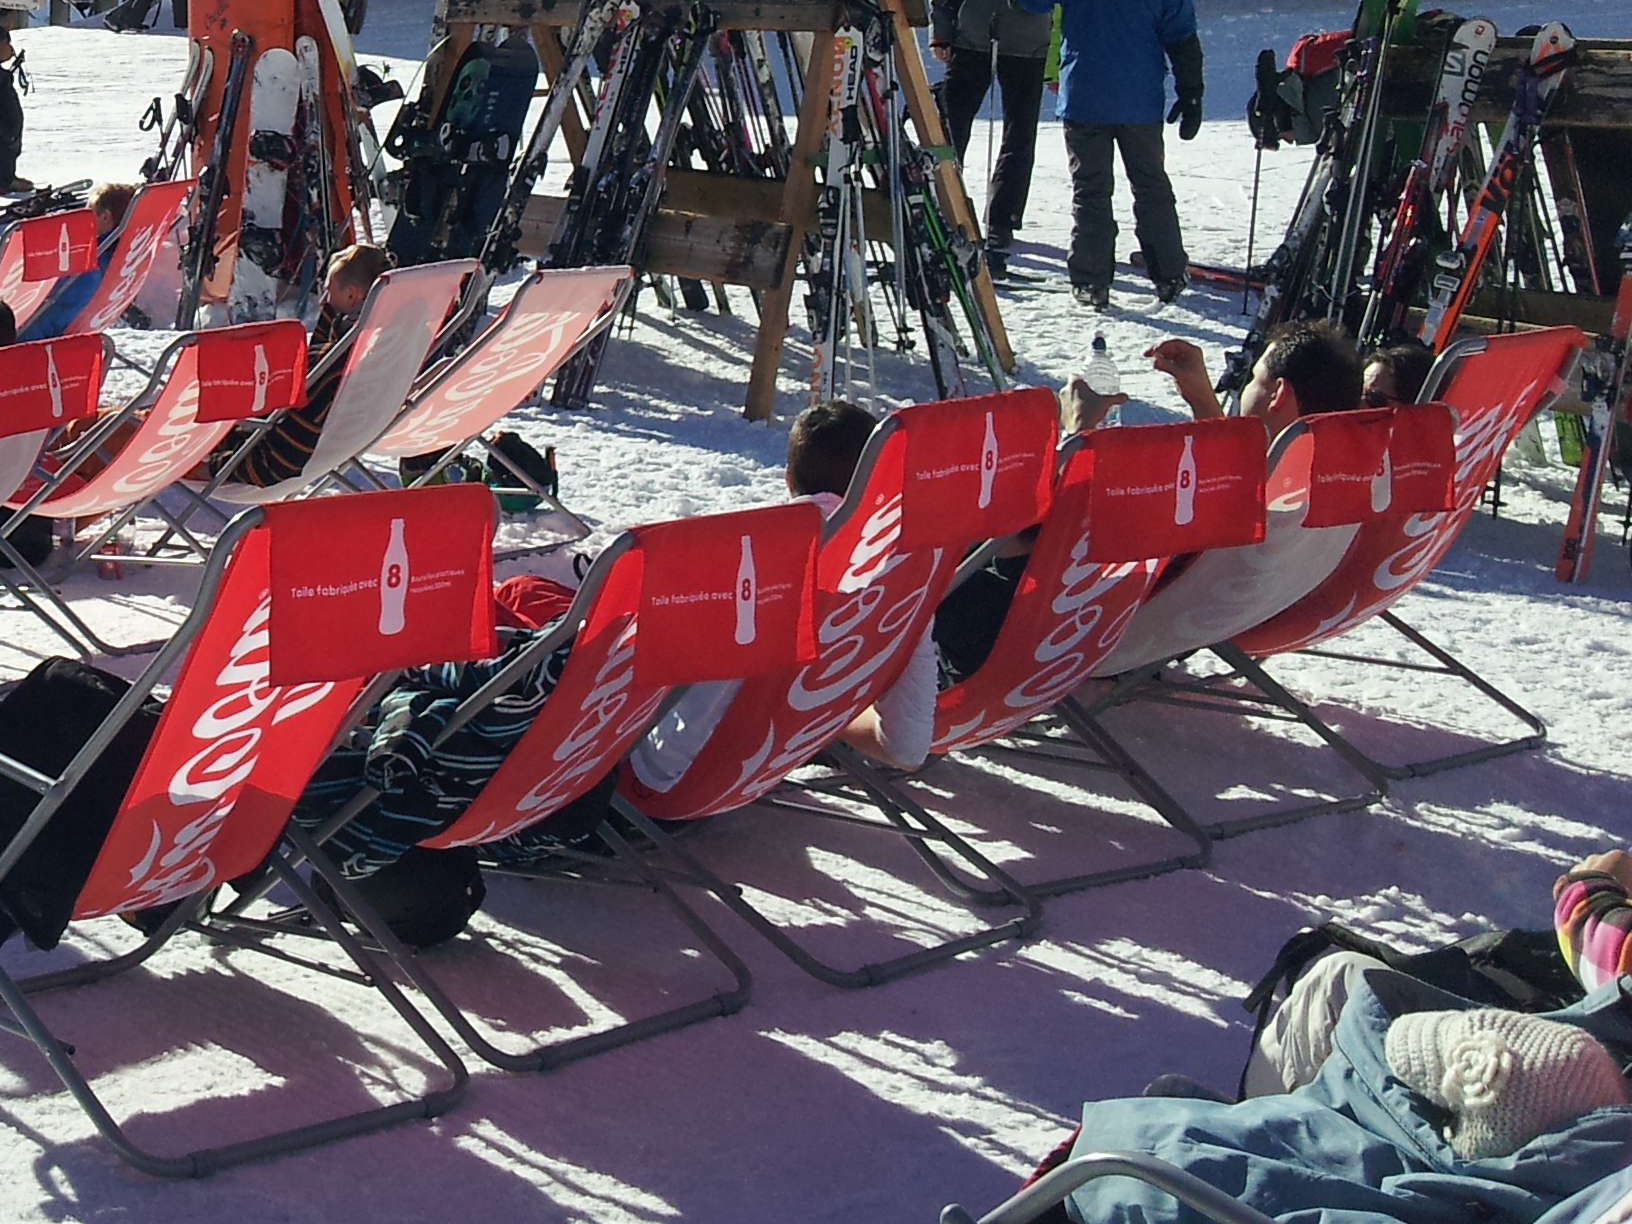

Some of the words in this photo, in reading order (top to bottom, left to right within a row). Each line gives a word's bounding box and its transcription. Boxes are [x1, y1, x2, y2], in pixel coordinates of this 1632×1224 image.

[845, 44, 858, 101] HEAD
[259, 371, 266, 385] 8
[986, 450, 993, 470] 8
[1106, 488, 1125, 496] Toile
[1127, 482, 1163, 495] fabriquée
[1180, 470, 1190, 488] 8
[291, 586, 315, 598] Toile
[316, 580, 357, 596] fabriquée
[358, 578, 378, 589] avec
[387, 564, 401, 588] 8
[652, 596, 669, 606] Toile
[671, 591, 709, 604] fabriquée
[711, 591, 734, 600] avec
[742, 578, 751, 601] 8
